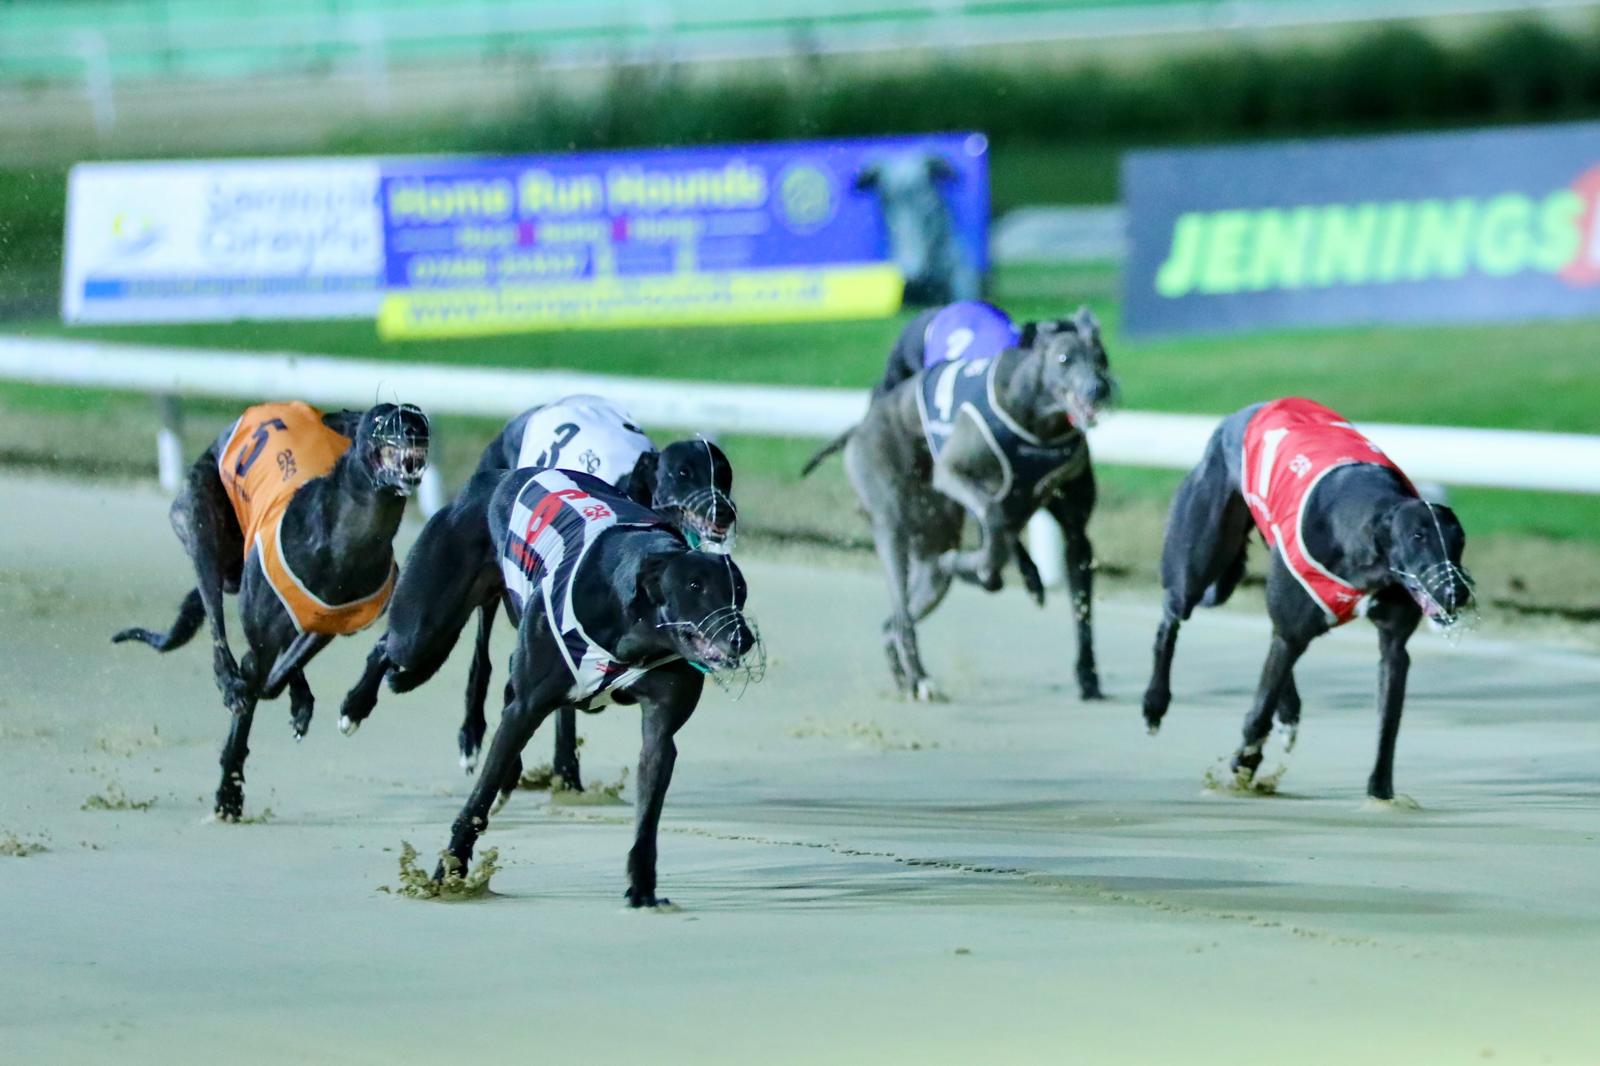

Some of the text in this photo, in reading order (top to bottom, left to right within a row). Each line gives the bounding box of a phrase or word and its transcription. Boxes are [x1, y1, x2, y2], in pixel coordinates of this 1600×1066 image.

[390, 179, 511, 219] Home
[521, 171, 598, 212] Run
[608, 162, 766, 208] Hounds
[1156, 191, 1582, 298] JENNINGS
[235, 418, 288, 477] 5
[536, 422, 580, 469] 3
[1259, 428, 1289, 498] 1
[525, 488, 589, 544] 6
